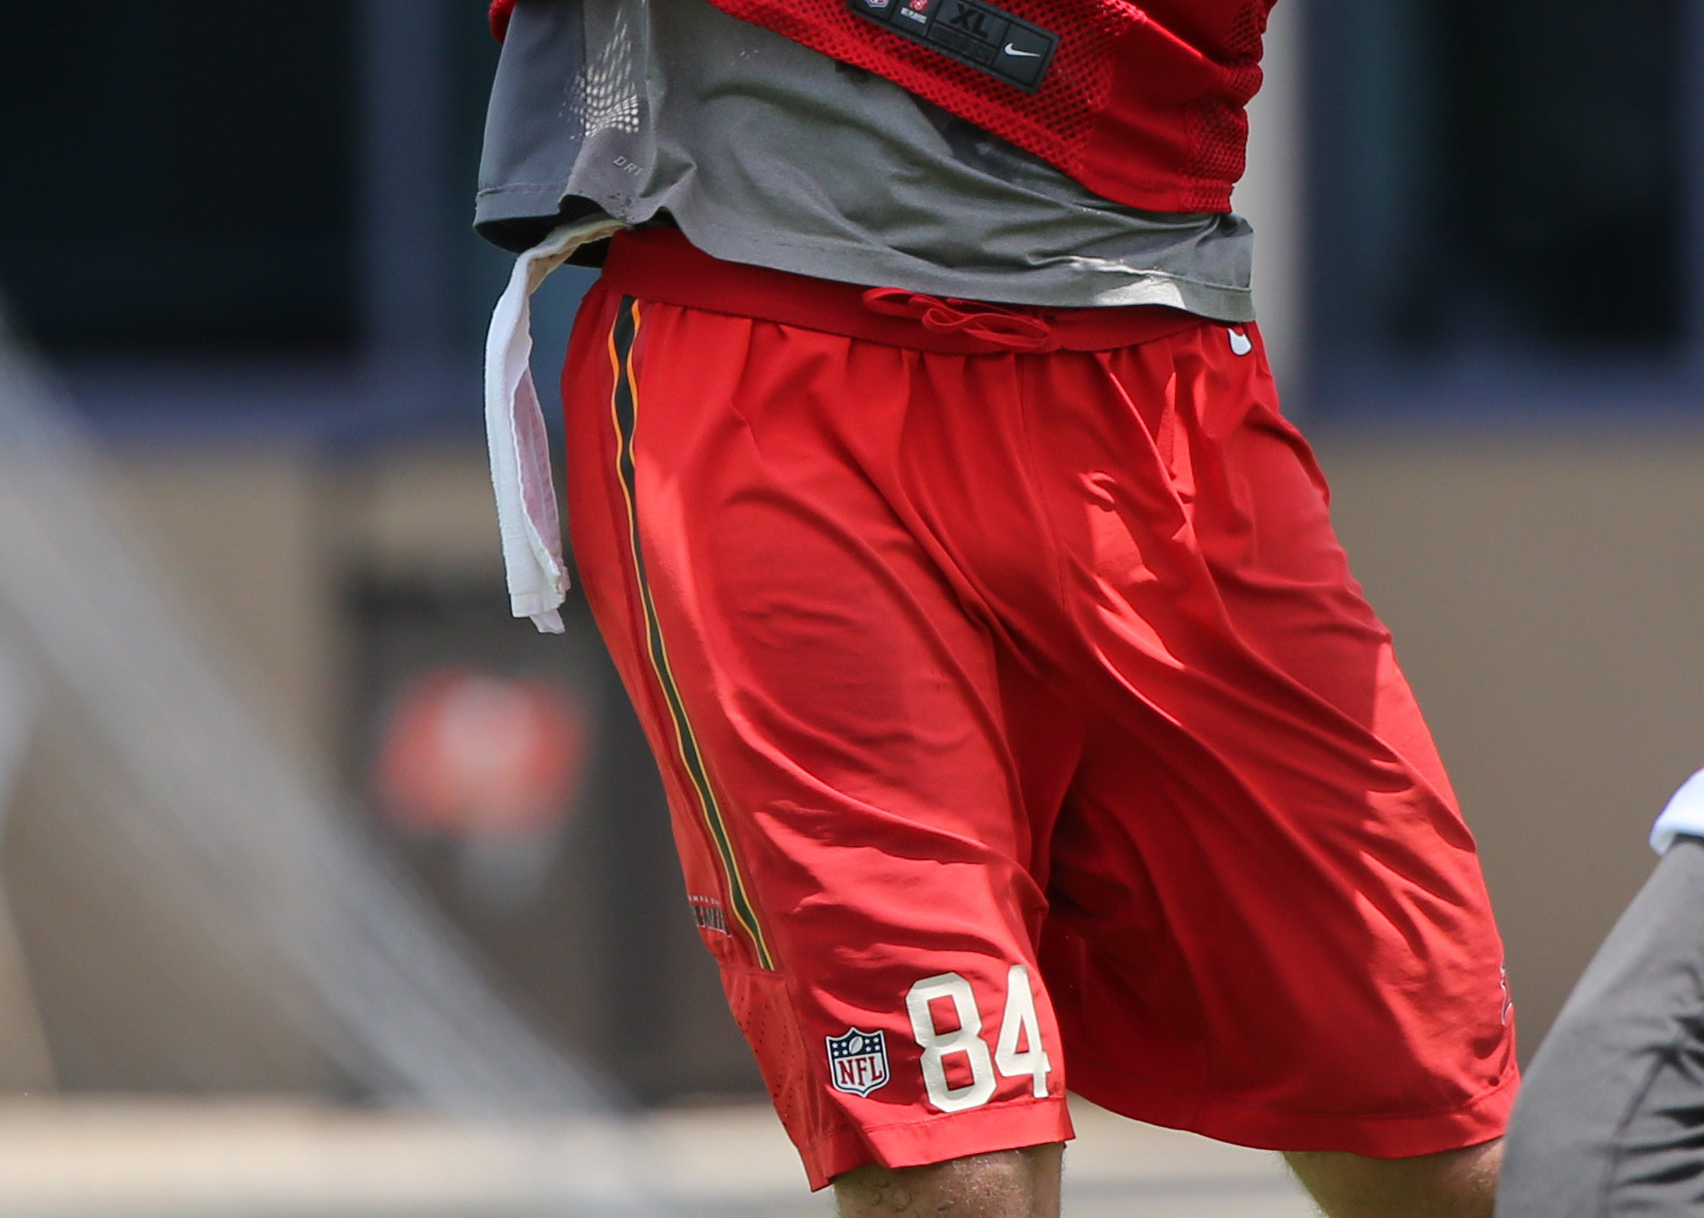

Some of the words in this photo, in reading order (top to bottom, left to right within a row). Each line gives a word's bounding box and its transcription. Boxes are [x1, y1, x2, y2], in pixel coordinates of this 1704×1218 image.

[949, 3, 989, 38] XL
[904, 965, 1052, 1113] 84
[838, 1056, 883, 1087] NFL
